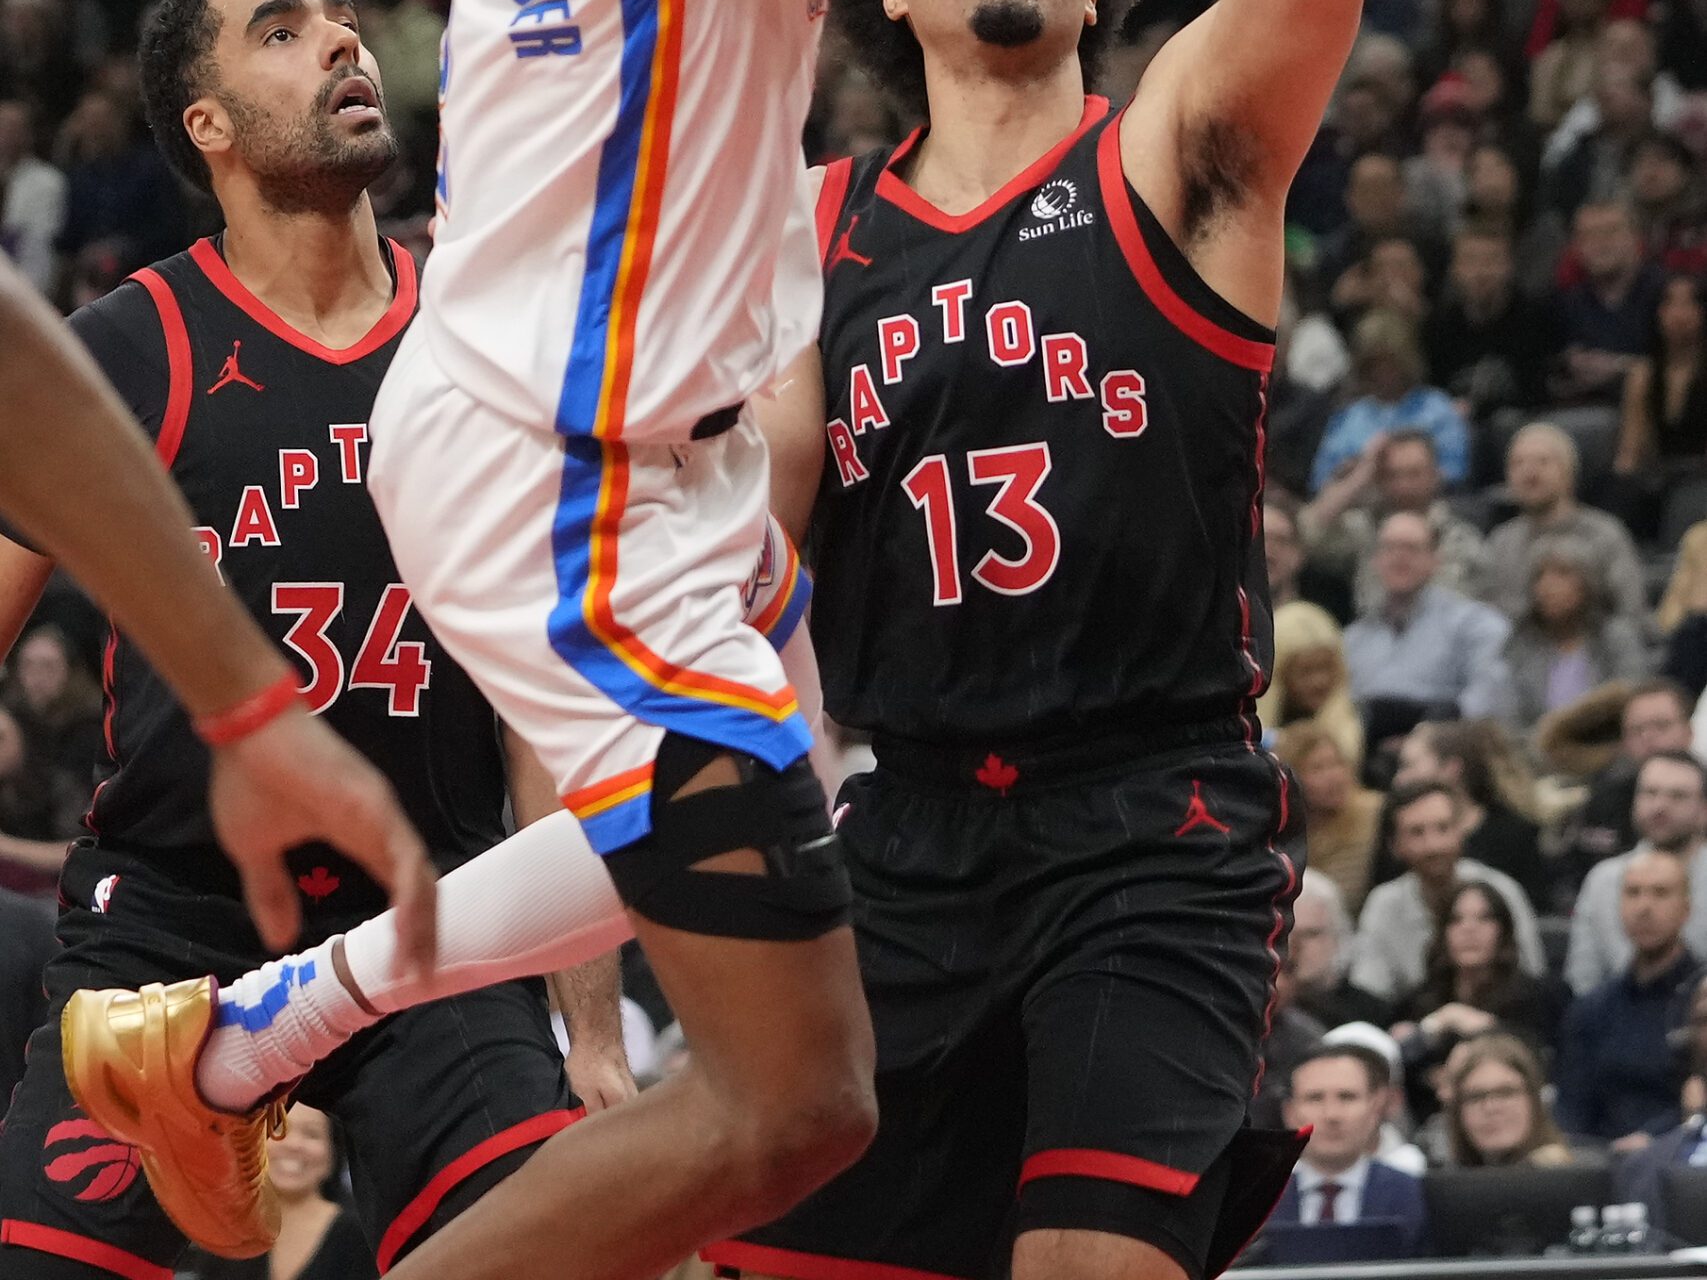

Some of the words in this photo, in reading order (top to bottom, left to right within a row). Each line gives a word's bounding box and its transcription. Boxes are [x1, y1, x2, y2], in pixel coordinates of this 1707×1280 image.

[1019, 223, 1055, 241] Sun
[1059, 210, 1094, 230] Life
[826, 279, 1148, 487] RAPTORS
[900, 441, 1061, 606] 13
[271, 582, 431, 717] 34
